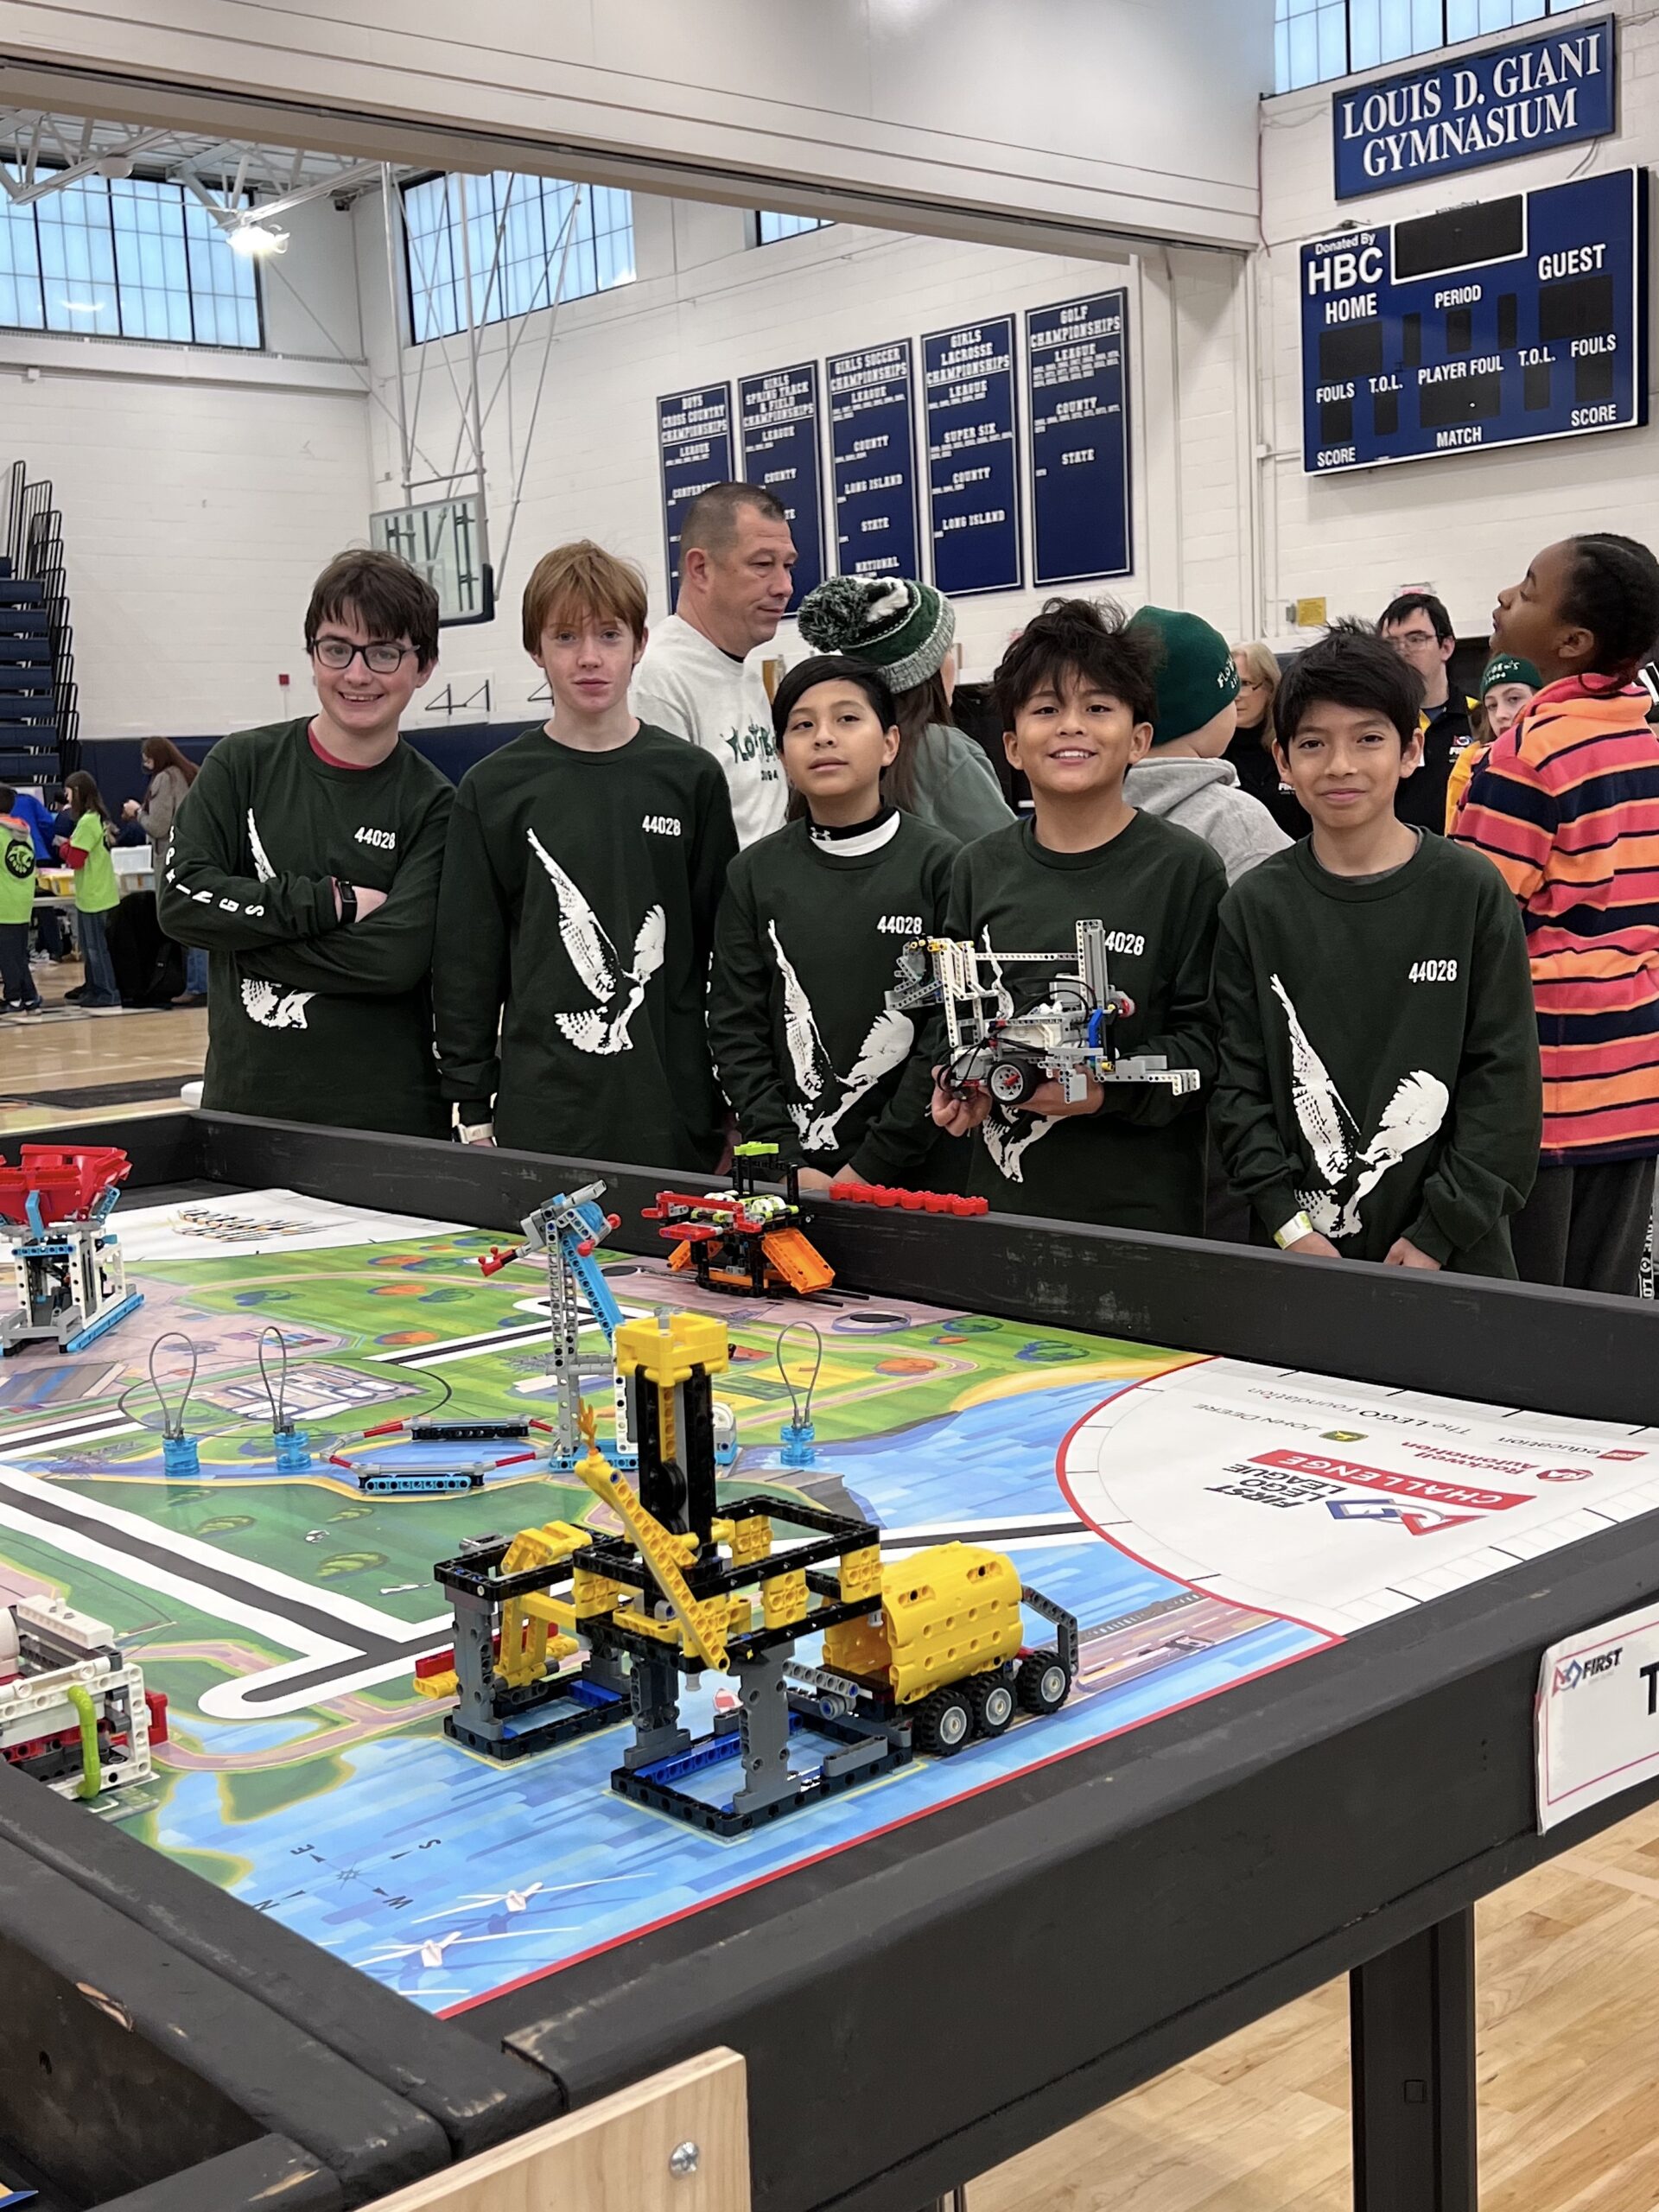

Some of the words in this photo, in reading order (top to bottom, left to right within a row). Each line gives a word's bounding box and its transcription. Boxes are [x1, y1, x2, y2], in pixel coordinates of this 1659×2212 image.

[1342, 78, 1441, 140] LOUIS
[1452, 70, 1485, 111] D.
[1493, 34, 1601, 99] GIANI
[1363, 87, 1578, 177] GYMNASIUM
[1315, 236, 1358, 255] Donated
[1361, 232, 1376, 245] By
[1308, 246, 1383, 296] HBC
[1538, 244, 1606, 281] GUEST
[1434, 284, 1482, 309] PERIOD
[1060, 305, 1088, 324] GOLF
[1325, 292, 1377, 324] HOME
[950, 329, 982, 348] GIRLS
[1031, 315, 1120, 348] CHAMPIONSHIPS
[940, 342, 994, 366] LACROSSE
[1055, 343, 1096, 362] LEAGUE
[1518, 346, 1556, 366] T.O.L.
[1571, 334, 1616, 358] FOULS
[835, 357, 863, 375] GIRLS
[865, 347, 900, 367] SOCCER
[926, 354, 1010, 385] CHAMPIONSHIPS
[1418, 362, 1466, 385] PLAYER
[1470, 355, 1504, 376] FOUL
[830, 362, 907, 391] CHAMPIONSHIPS
[1369, 374, 1403, 393] T.O.L.
[851, 385, 887, 404] LEAGUE
[949, 379, 988, 398] LEAGUE
[1316, 382, 1355, 404] FOULS
[743, 403, 814, 428] CHAMPIONSHIPS
[1056, 397, 1097, 415] COUNTY
[1571, 404, 1617, 427] SCORE
[662, 419, 728, 443] CHAMPIONSHIPS
[762, 426, 795, 442] LEAGUE
[944, 427, 976, 443] SUPER
[977, 423, 996, 436] SIX
[1436, 426, 1482, 448] MATCH
[679, 442, 709, 457] LEAGUE
[853, 435, 889, 452] COUNTY
[1062, 448, 1095, 465] STATE
[1317, 447, 1356, 467] SCORE
[764, 467, 797, 484] COUNTY
[844, 480, 868, 495] LONG
[868, 474, 903, 490] ISLAND
[952, 467, 991, 484] COUNTY
[861, 517, 890, 532] STATE
[942, 516, 967, 531] LONG
[969, 510, 1005, 526] ISLAND
[642, 815, 681, 836] 44028
[354, 826, 396, 850] 44028
[877, 915, 922, 934] 44028
[1104, 931, 1145, 956] 4028
[1408, 959, 1458, 983] 44028
[1192, 1402, 1258, 1420] DEERE
[1248, 1388, 1359, 1413] Foundation
[1265, 1417, 1322, 1431] JOHN
[1360, 1410, 1428, 1426] LEGO
[1433, 1422, 1471, 1434] The
[1402, 1441, 1541, 1468] Automation
[1498, 1437, 1600, 1454] education
[1414, 1452, 1525, 1474] Rockwell
[1223, 1464, 1347, 1494] LEAGUE
[1278, 1455, 1503, 1504] CHALLENGE
[1204, 1484, 1304, 1508] FIRST
[1240, 1479, 1328, 1503] LEGO
[1583, 1647, 1623, 1679] FIRST
